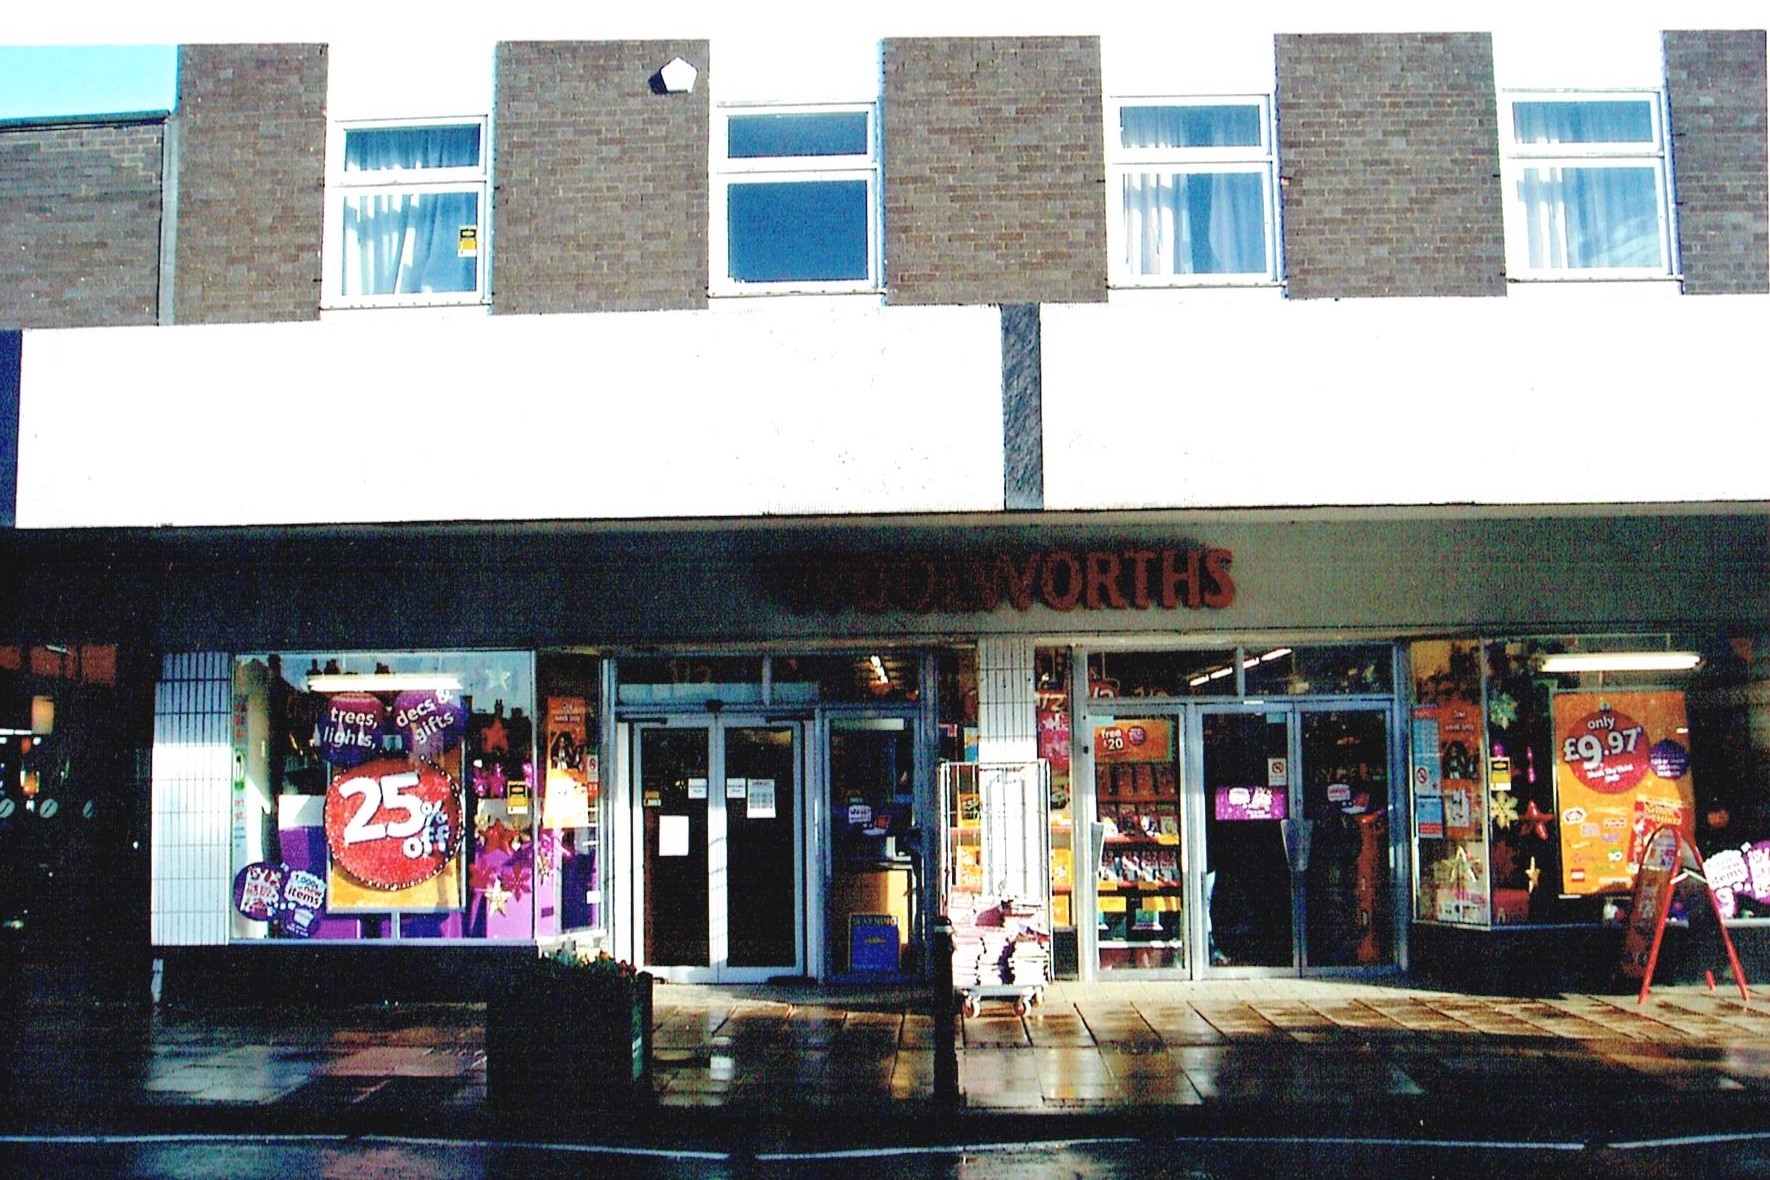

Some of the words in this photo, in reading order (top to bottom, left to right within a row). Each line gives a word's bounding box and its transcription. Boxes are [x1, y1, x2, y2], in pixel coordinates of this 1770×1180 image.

[330, 706, 378, 729] trees,
[396, 697, 437, 728] decs
[435, 688, 454, 704] &
[415, 712, 455, 745] gifts
[1101, 728, 1121, 739] free
[1587, 716, 1615, 730] only
[323, 726, 376, 749] lights,
[338, 771, 448, 847] 25%
[402, 825, 450, 859] off
[288, 886, 319, 905] items
[303, 885, 322, 897] new
